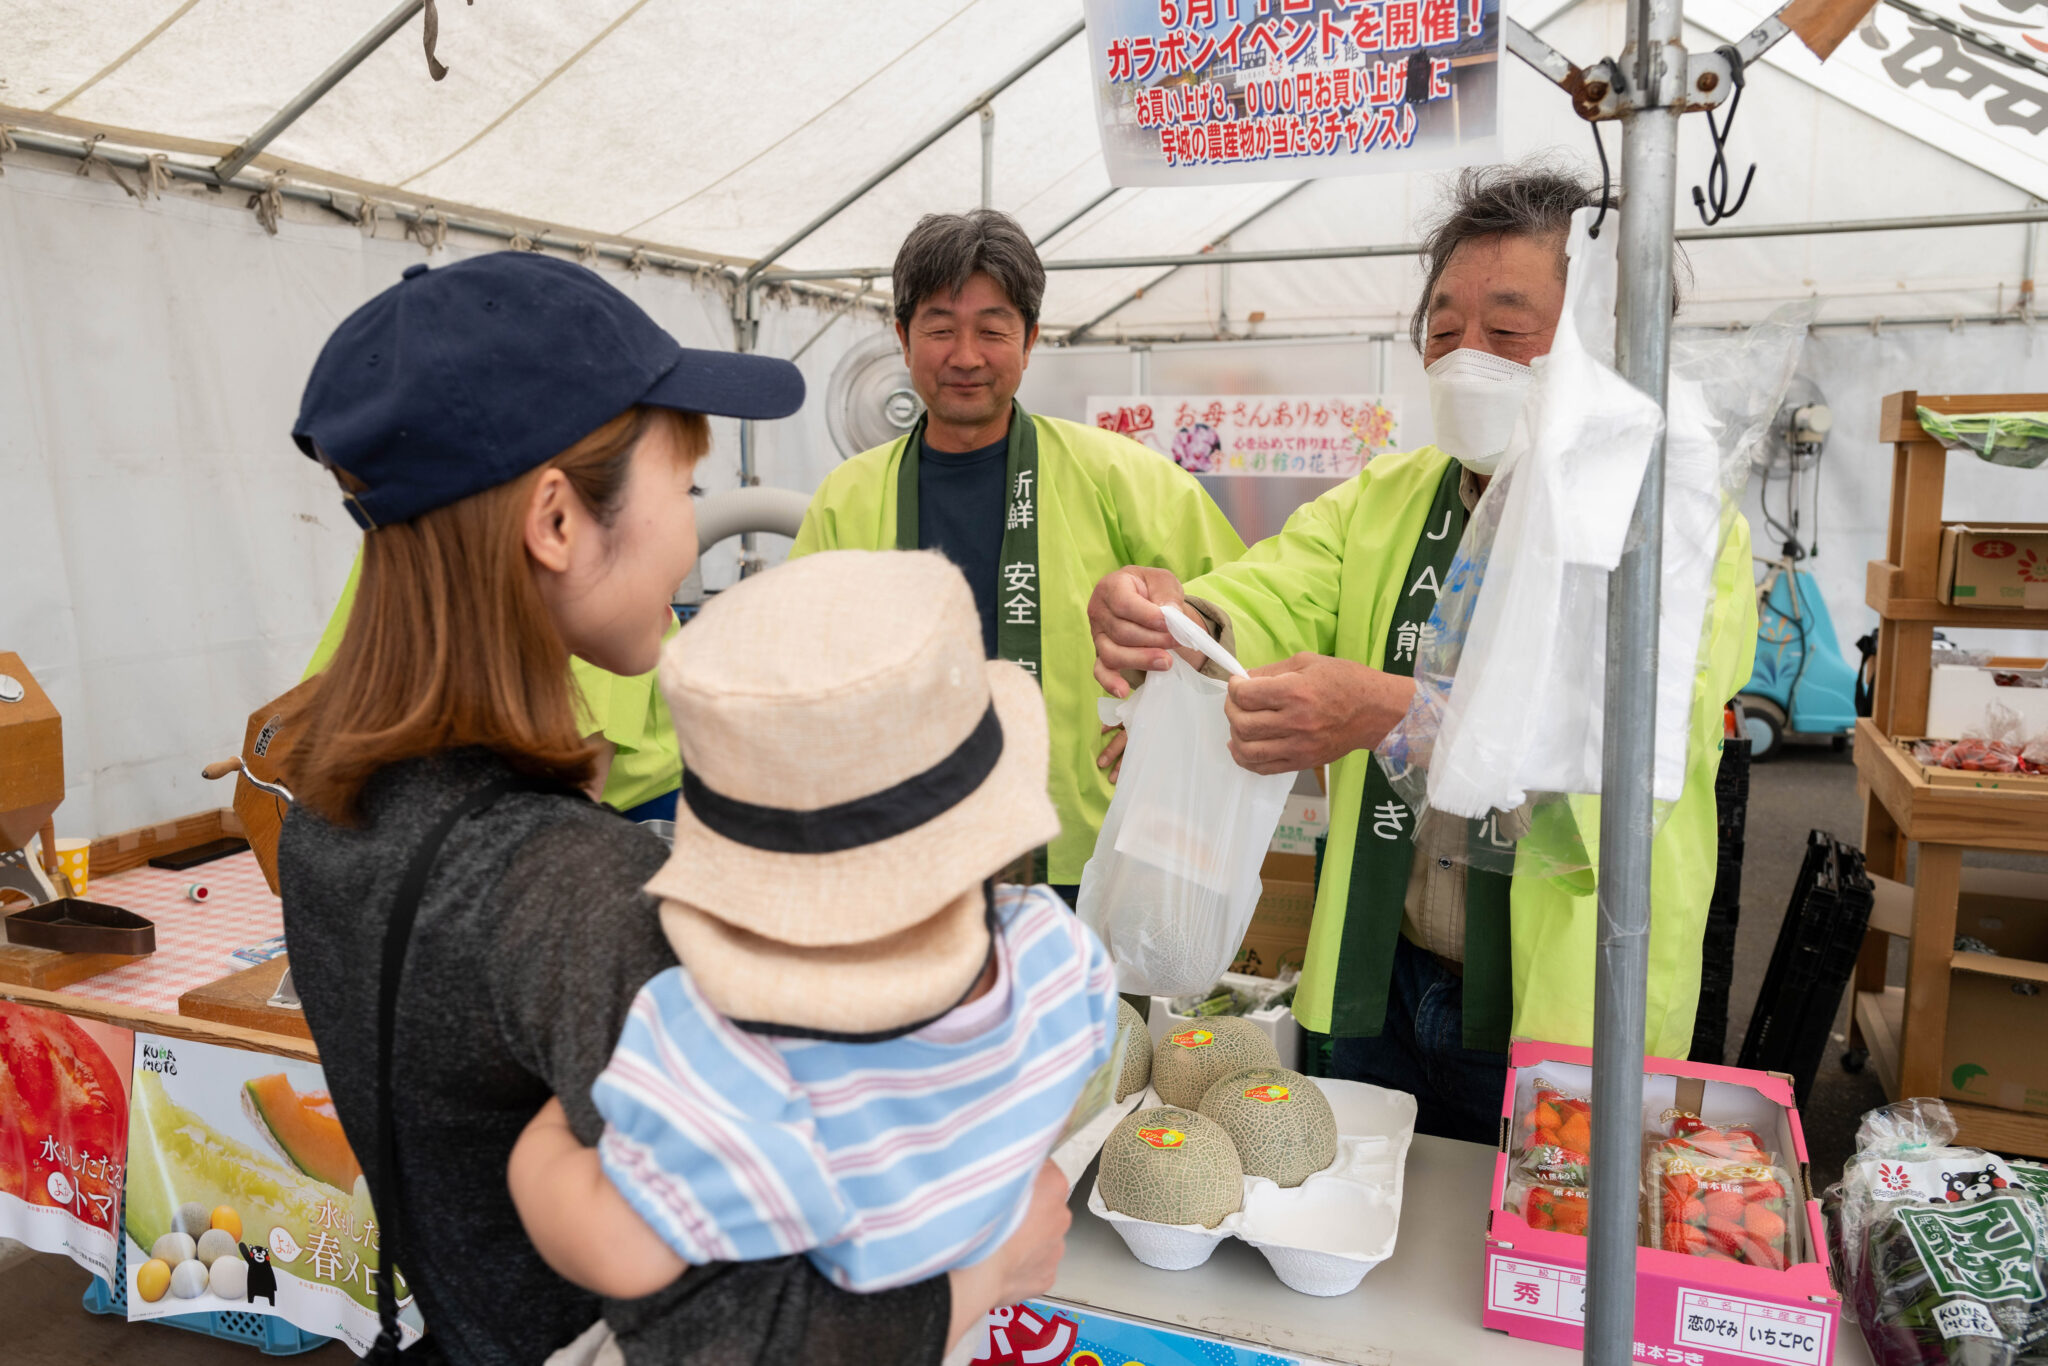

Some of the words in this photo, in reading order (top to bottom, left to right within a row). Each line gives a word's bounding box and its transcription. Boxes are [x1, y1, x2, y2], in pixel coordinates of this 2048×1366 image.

[1008, 470, 1035, 530] 新鮮
[1004, 561, 1037, 624] 安全
[143, 1044, 176, 1061] KUMA
[143, 1060, 177, 1075] MOTO
[39, 1135, 123, 1189] 水もしたたる
[1513, 1281, 1541, 1305] 秀
[1687, 1314, 1738, 1338] 恋のぞみ
[1749, 1326, 1814, 1352] いちごPC
